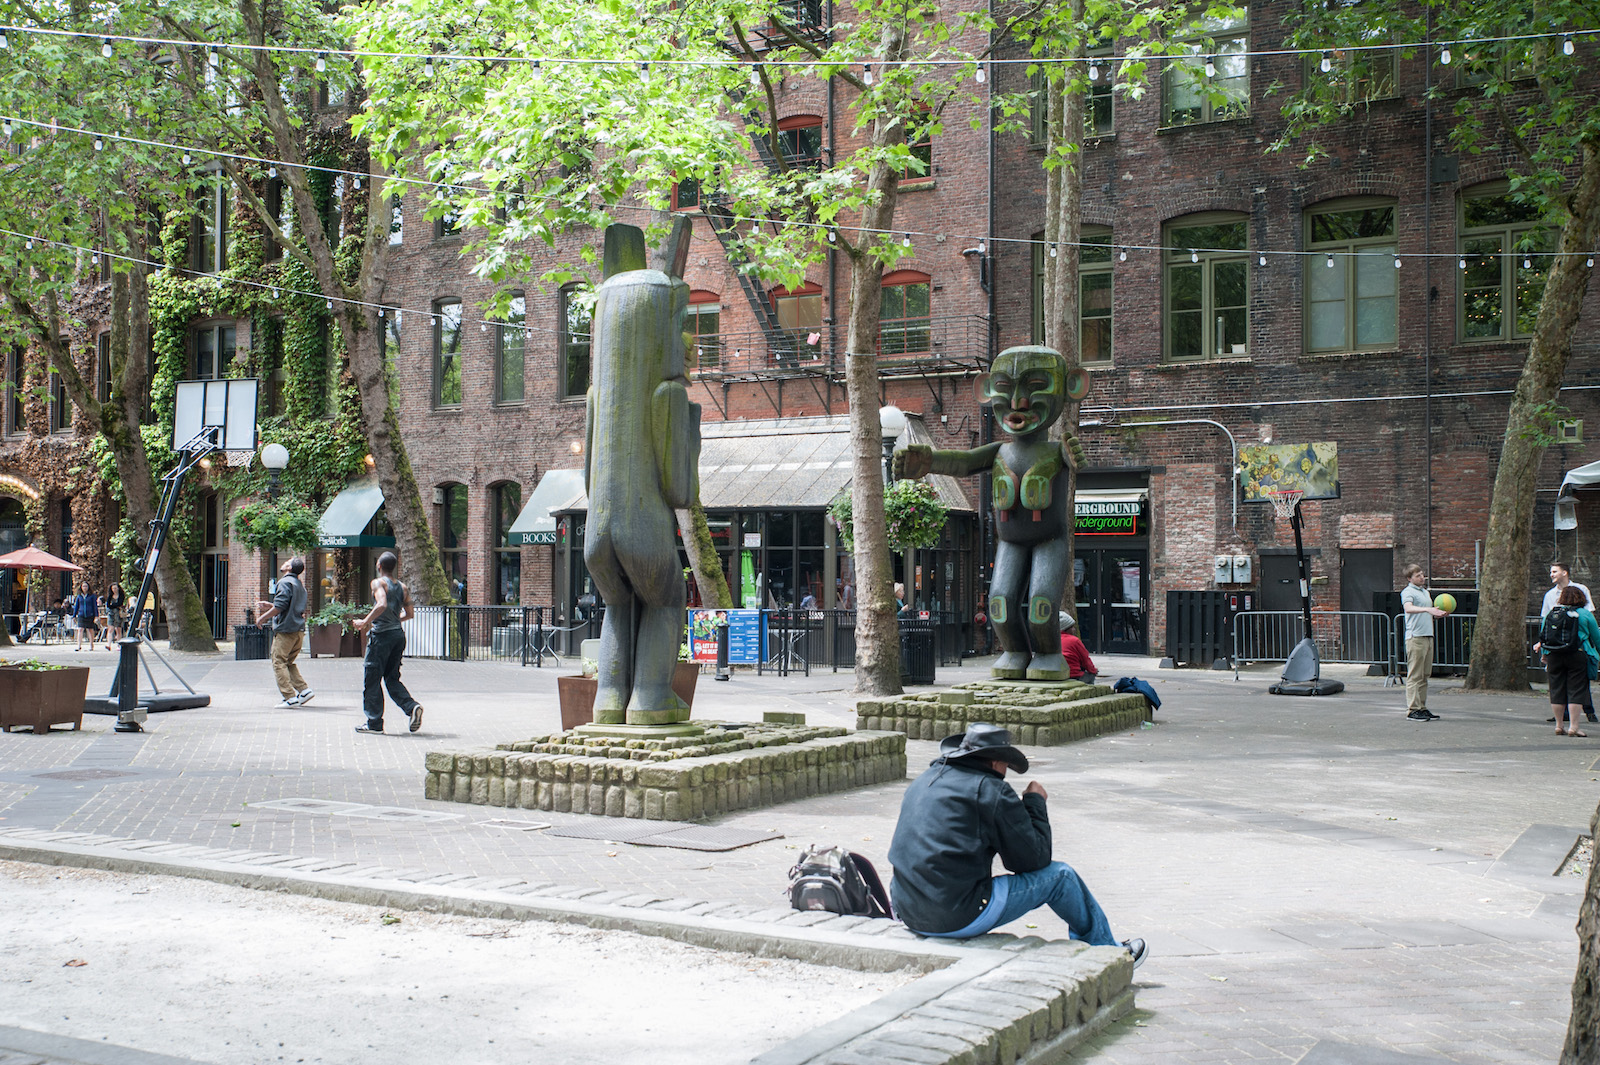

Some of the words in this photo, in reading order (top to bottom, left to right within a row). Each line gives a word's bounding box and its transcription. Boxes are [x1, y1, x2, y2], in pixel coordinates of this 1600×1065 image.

[1074, 502, 1140, 514] ERGROUND
[1074, 515, 1133, 530] nderground
[522, 533, 556, 543] BOOKS
